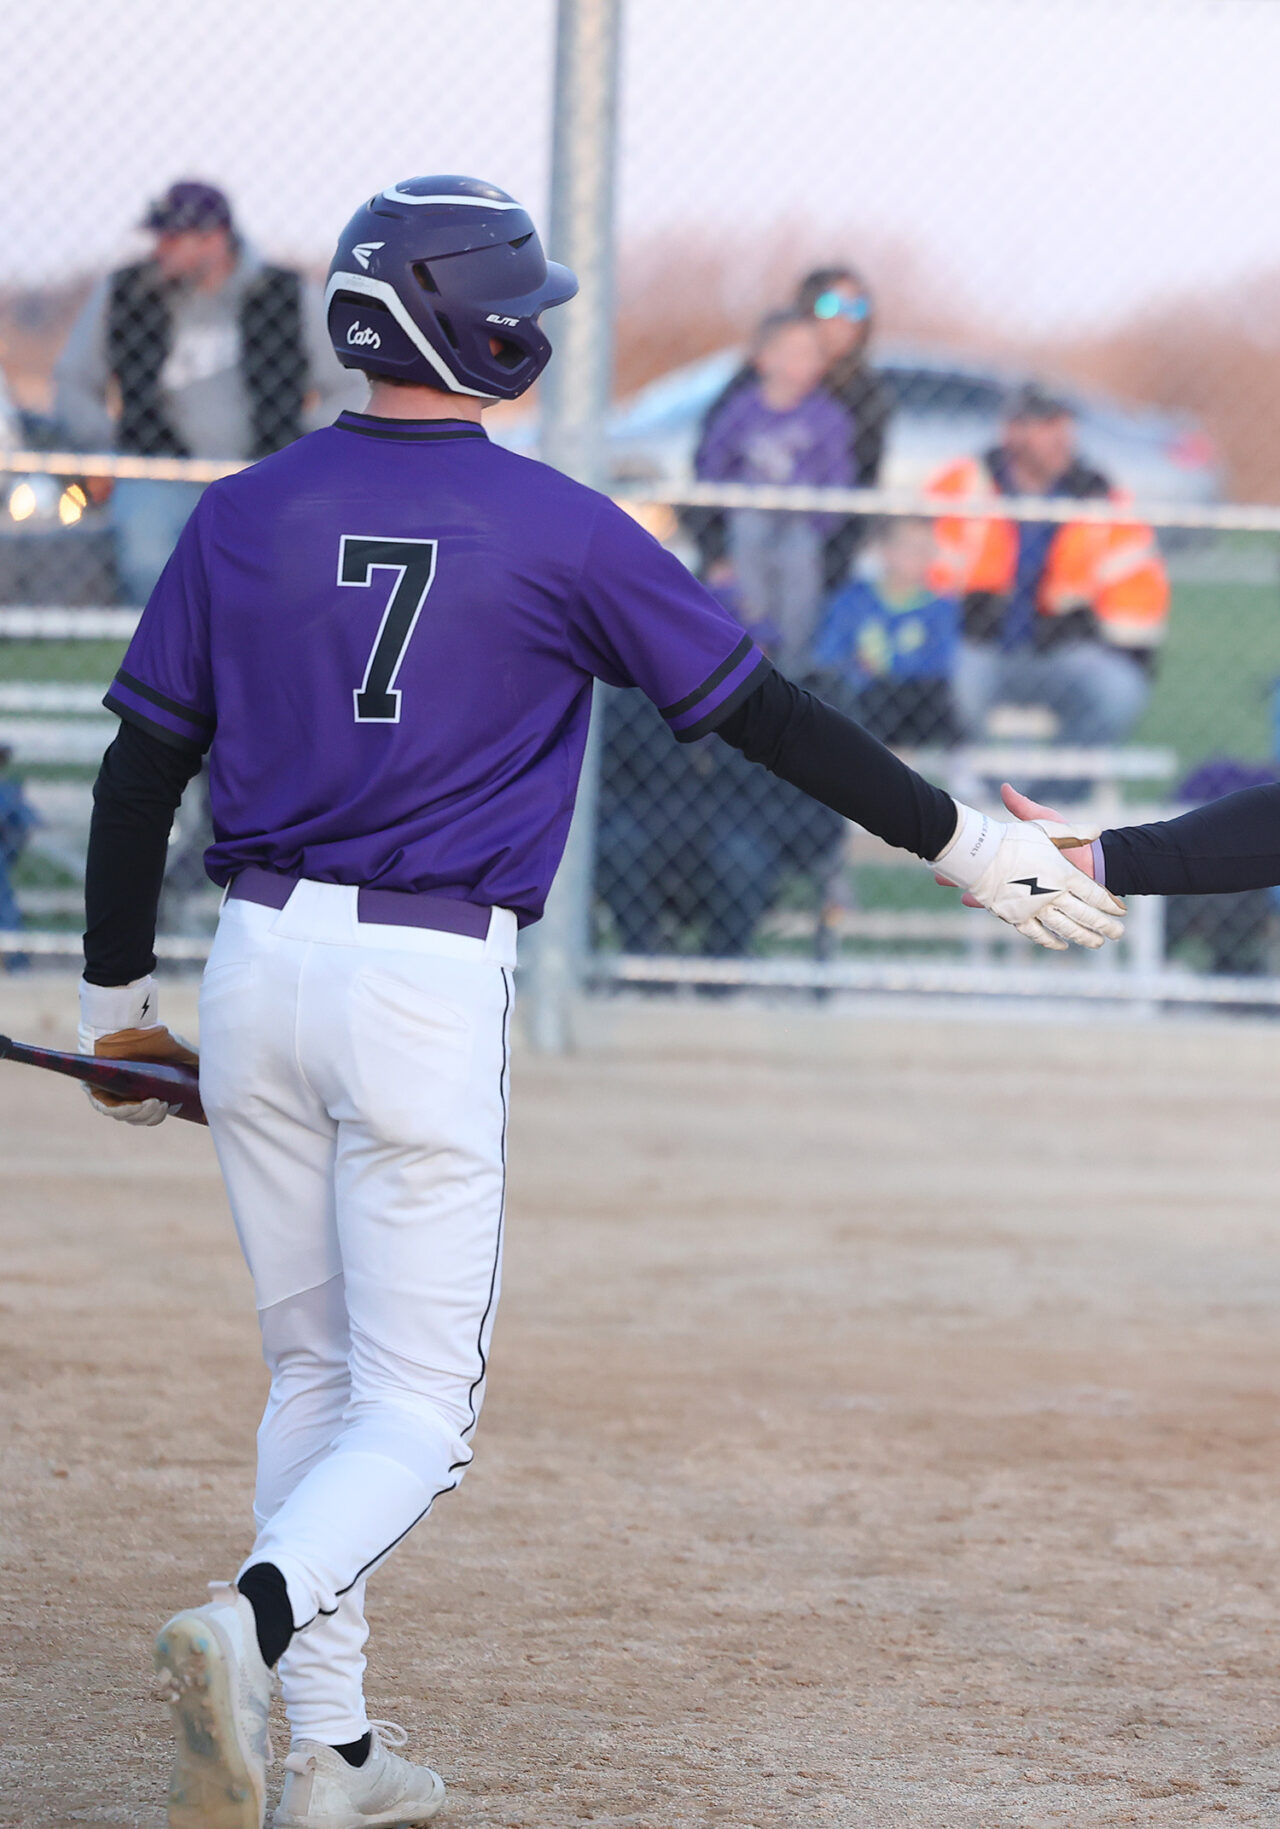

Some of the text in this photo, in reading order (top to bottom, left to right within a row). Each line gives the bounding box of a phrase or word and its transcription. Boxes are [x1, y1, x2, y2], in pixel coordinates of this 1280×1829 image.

[346, 320, 381, 350] Cats
[486, 314, 520, 327] ELITE
[336, 534, 439, 724] 7
